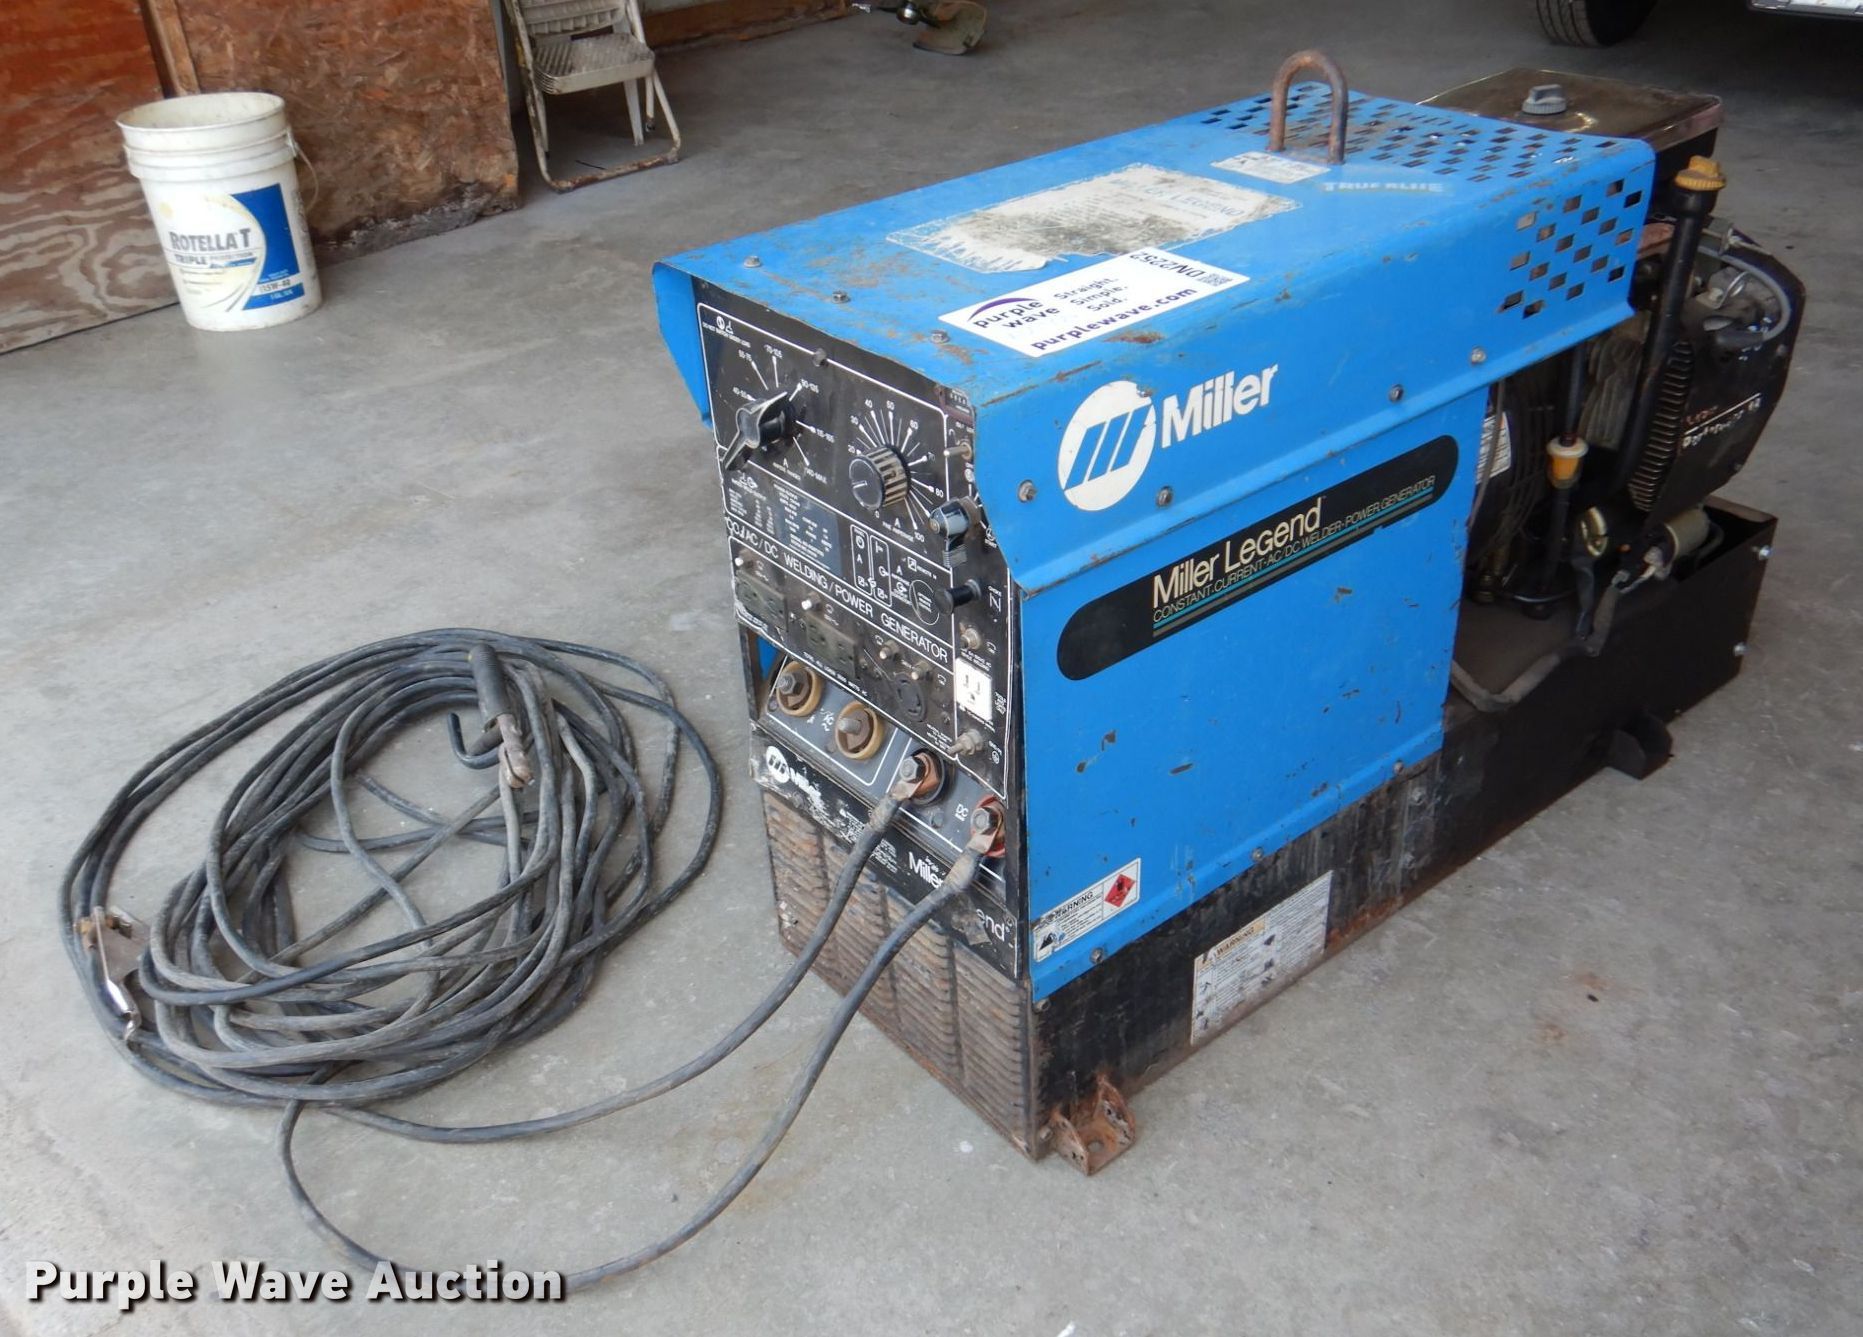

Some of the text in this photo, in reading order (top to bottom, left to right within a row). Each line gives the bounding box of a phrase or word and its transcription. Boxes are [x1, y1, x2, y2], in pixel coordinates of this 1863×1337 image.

[169, 228, 252, 252] ROTELLA T
[1053, 277, 1120, 301] Straight.
[1069, 286, 1129, 306] Simple.
[973, 300, 1045, 329] purple
[1086, 298, 1129, 312] Sold.
[1002, 306, 1061, 329] wave
[1031, 288, 1198, 350] purplewave.com
[865, 399, 873, 409] 40
[1161, 364, 1279, 449] Miller
[935, 488, 944, 498] 80
[1153, 474, 1436, 622] CONSTANT CURRENT AC/DC WELDER POWER GENERATOR
[1153, 496, 1322, 609] Miller Legend
[880, 612, 949, 664] GENERATOR
[956, 803, 969, 818] DC
